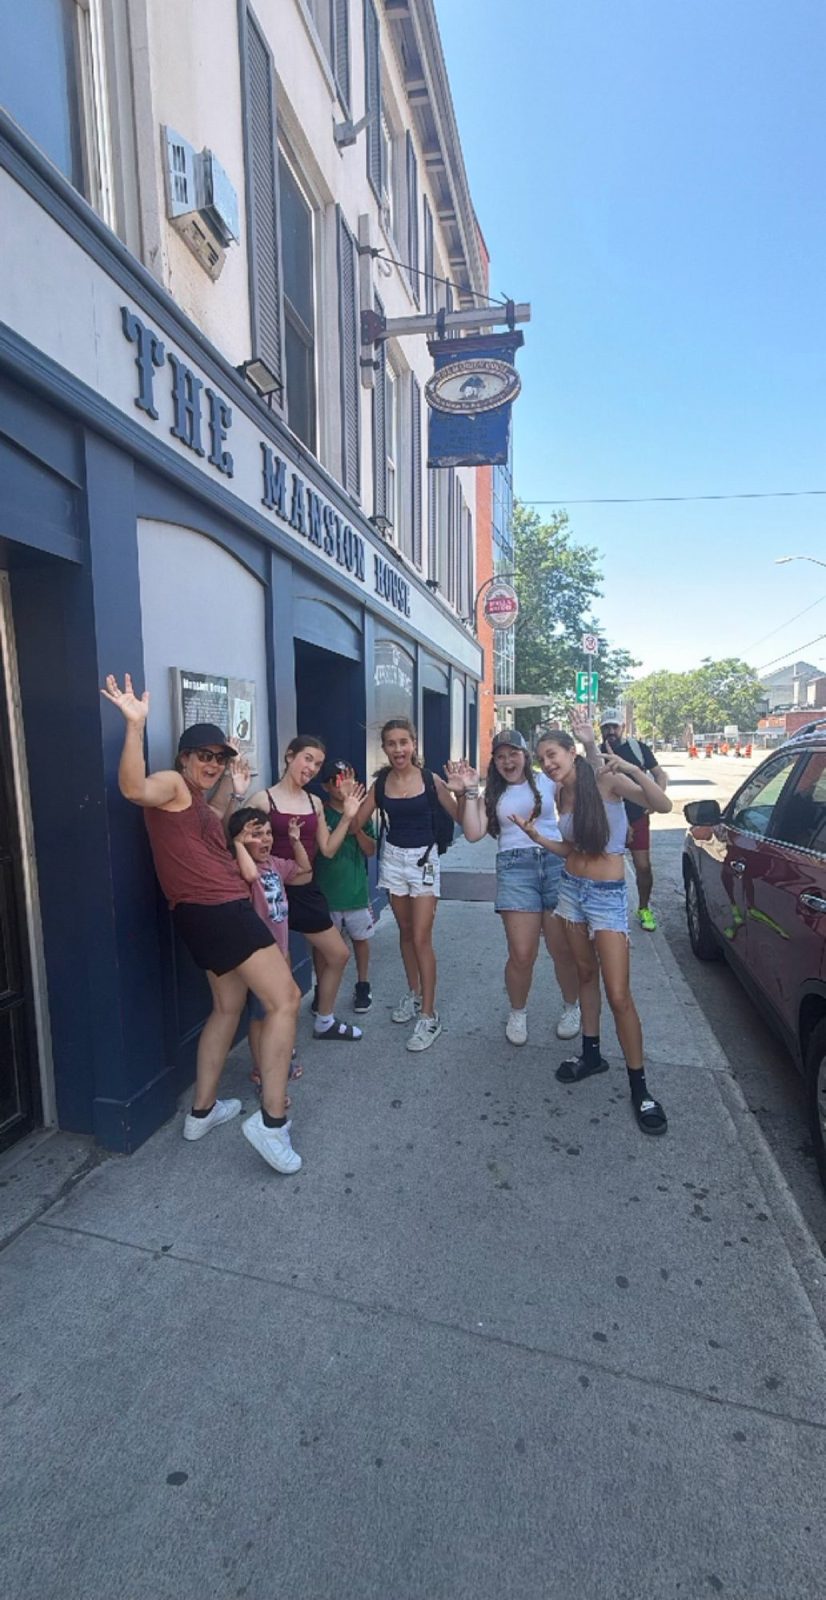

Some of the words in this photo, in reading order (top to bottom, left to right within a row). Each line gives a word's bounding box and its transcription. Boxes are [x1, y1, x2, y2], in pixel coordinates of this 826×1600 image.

[120, 306, 233, 479] THE
[259, 441, 366, 582] MANSION
[373, 553, 411, 618] HOUSE
[581, 676, 593, 690] P
